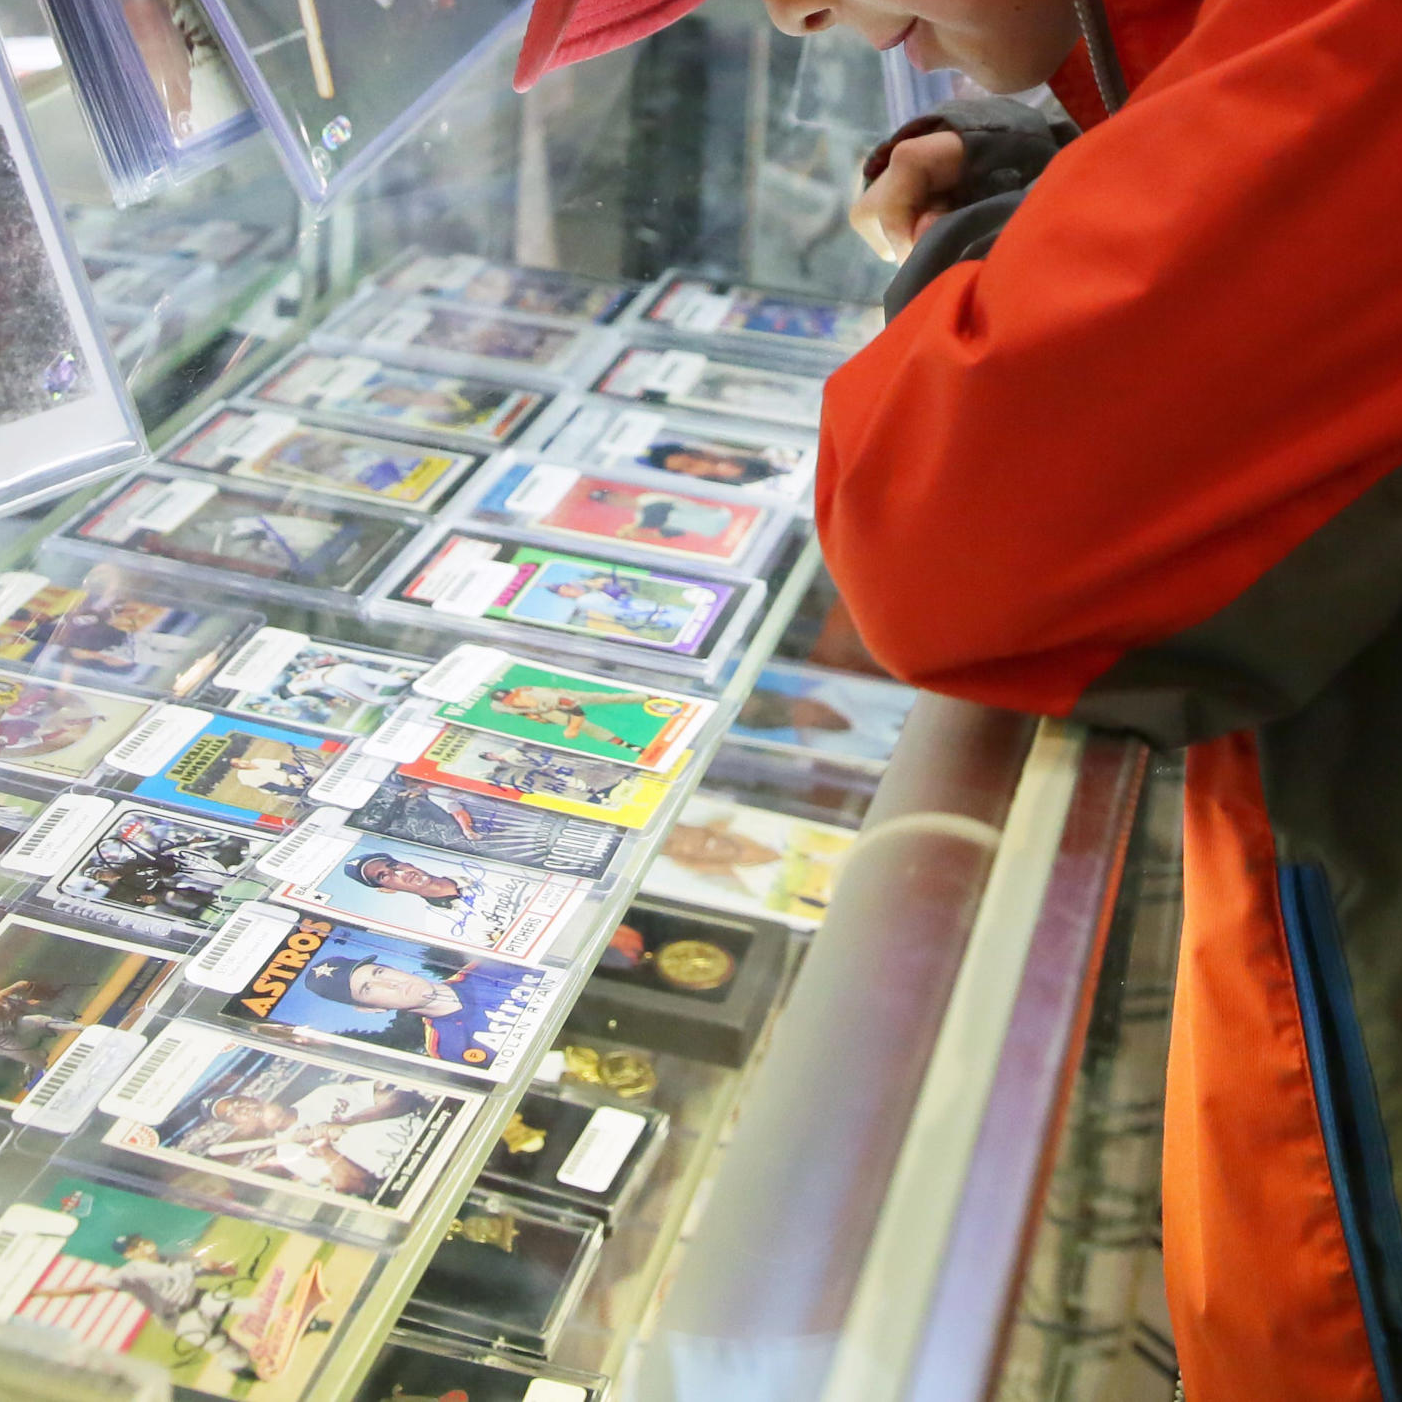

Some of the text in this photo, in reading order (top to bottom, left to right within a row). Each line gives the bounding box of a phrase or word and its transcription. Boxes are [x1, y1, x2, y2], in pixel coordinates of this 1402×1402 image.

[240, 919, 334, 1019] ASTROS
[505, 916, 543, 953] PITCHERS
[494, 978, 557, 1069] NOLAN RYAN
